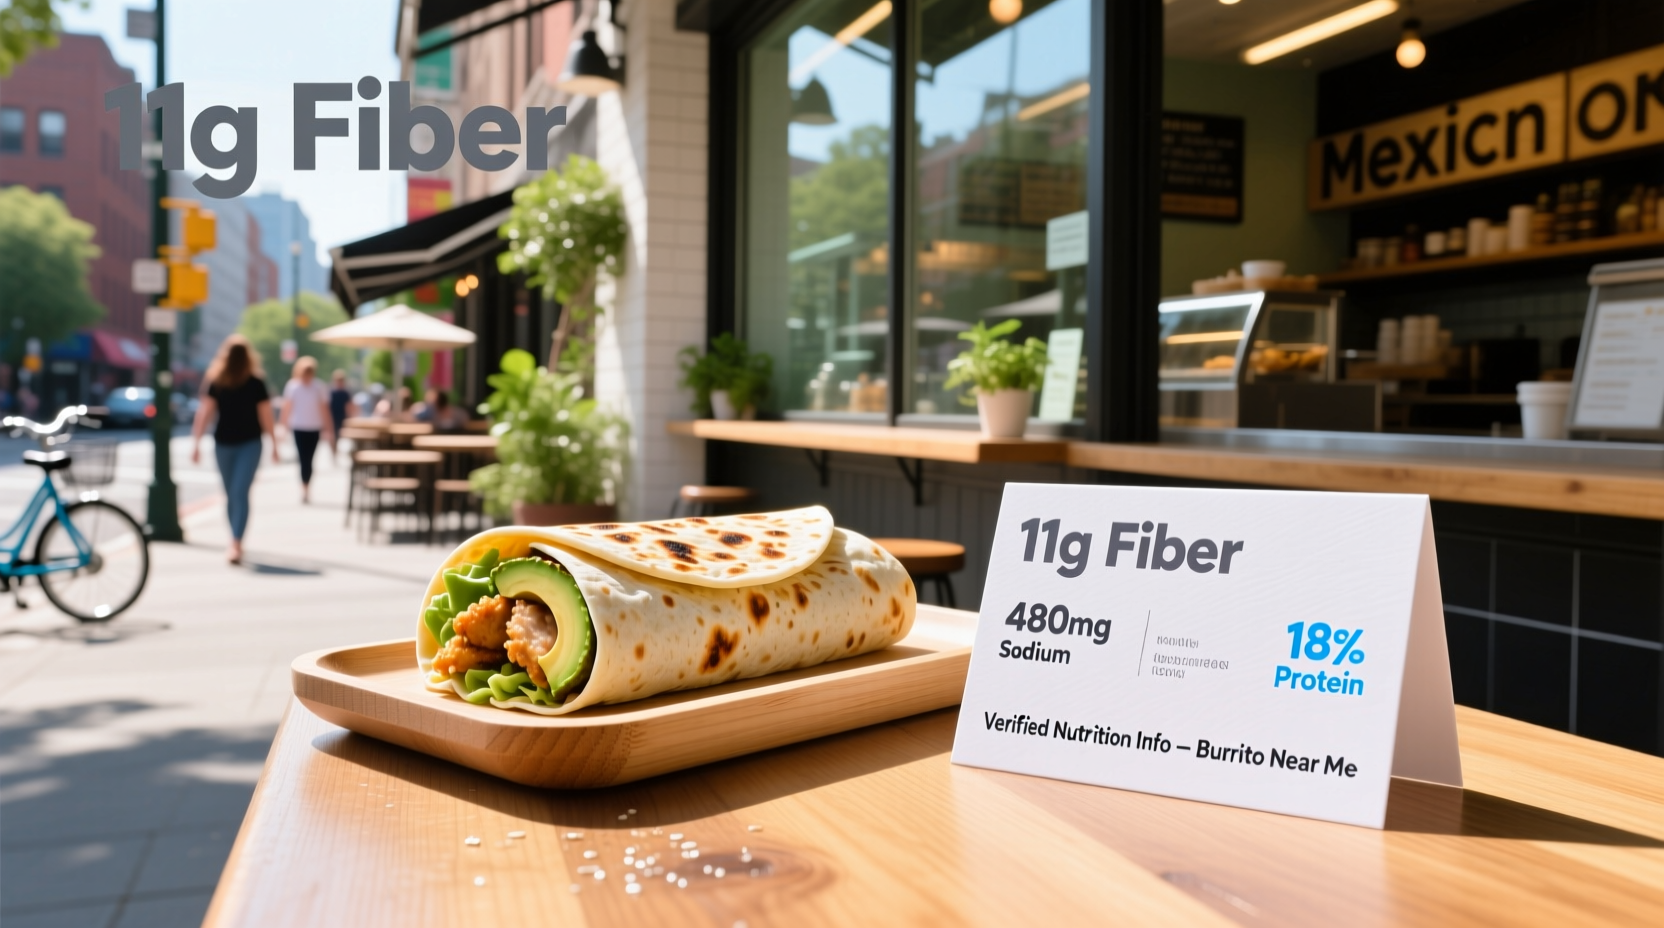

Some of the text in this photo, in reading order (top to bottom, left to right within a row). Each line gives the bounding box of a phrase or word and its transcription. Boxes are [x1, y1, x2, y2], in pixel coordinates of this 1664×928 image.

[1321, 102, 1546, 200] Mexicn
[1020, 517, 1245, 579] 11g Fiber
[1004, 601, 1112, 646] 480mg
[1286, 621, 1366, 666] 18%
[998, 639, 1071, 665] Sodium
[1273, 664, 1365, 696] Protein
[984, 711, 1050, 737] Verified
[1053, 720, 1132, 749] Nutrition
[1136, 730, 1172, 754] Info
[1196, 738, 1265, 766] Burrito
[1269, 747, 1321, 774] Near
[1323, 754, 1358, 778] Me
